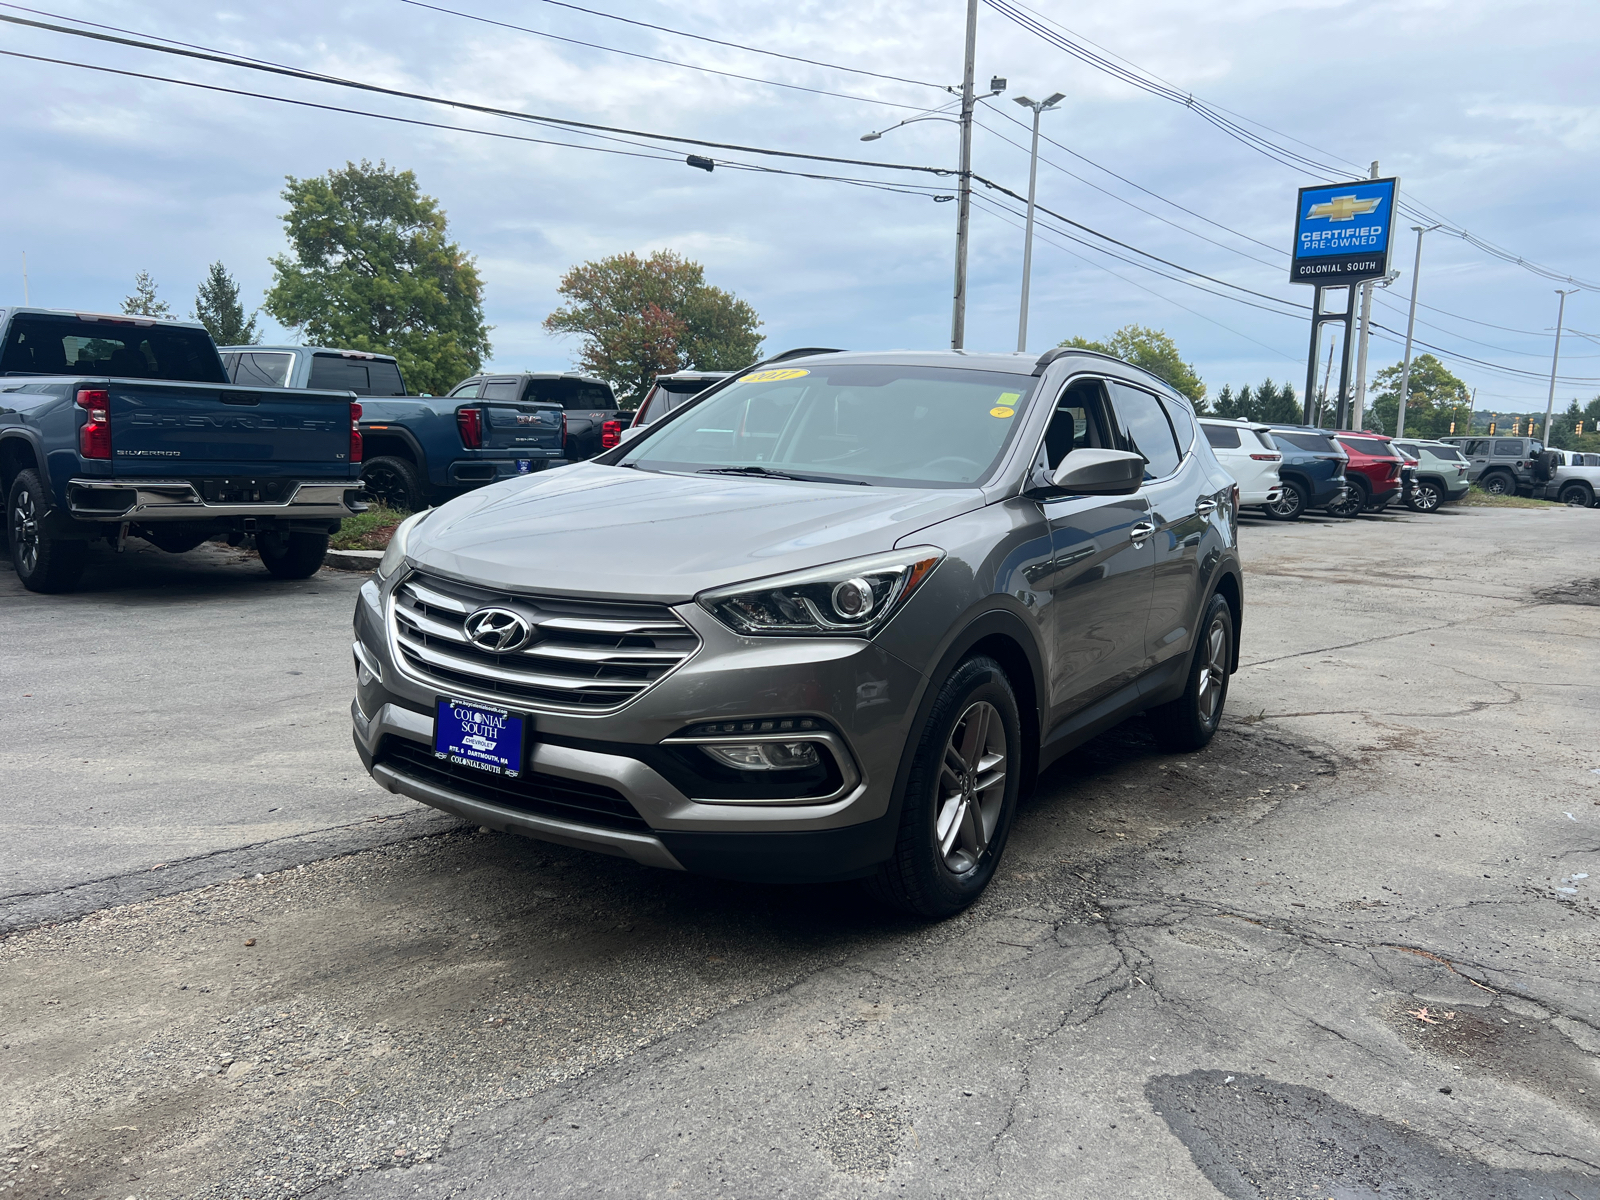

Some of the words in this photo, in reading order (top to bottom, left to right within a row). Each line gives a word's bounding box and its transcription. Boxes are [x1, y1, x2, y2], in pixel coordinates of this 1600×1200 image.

[1301, 226, 1382, 241] CERTIFIED
[1304, 236, 1377, 250] PRE-OWNED
[1300, 264, 1341, 274] COLONIAL
[1347, 262, 1376, 271] SOUTH
[516, 415, 542, 424] GMC
[454, 708, 506, 729] COLONIAL
[461, 721, 498, 739] SOUTH
[465, 737, 494, 749] CHEVROLET
[450, 755, 481, 769] COLONIAL
[480, 762, 501, 774] SOUTH
[500, 757, 509, 765] MA
